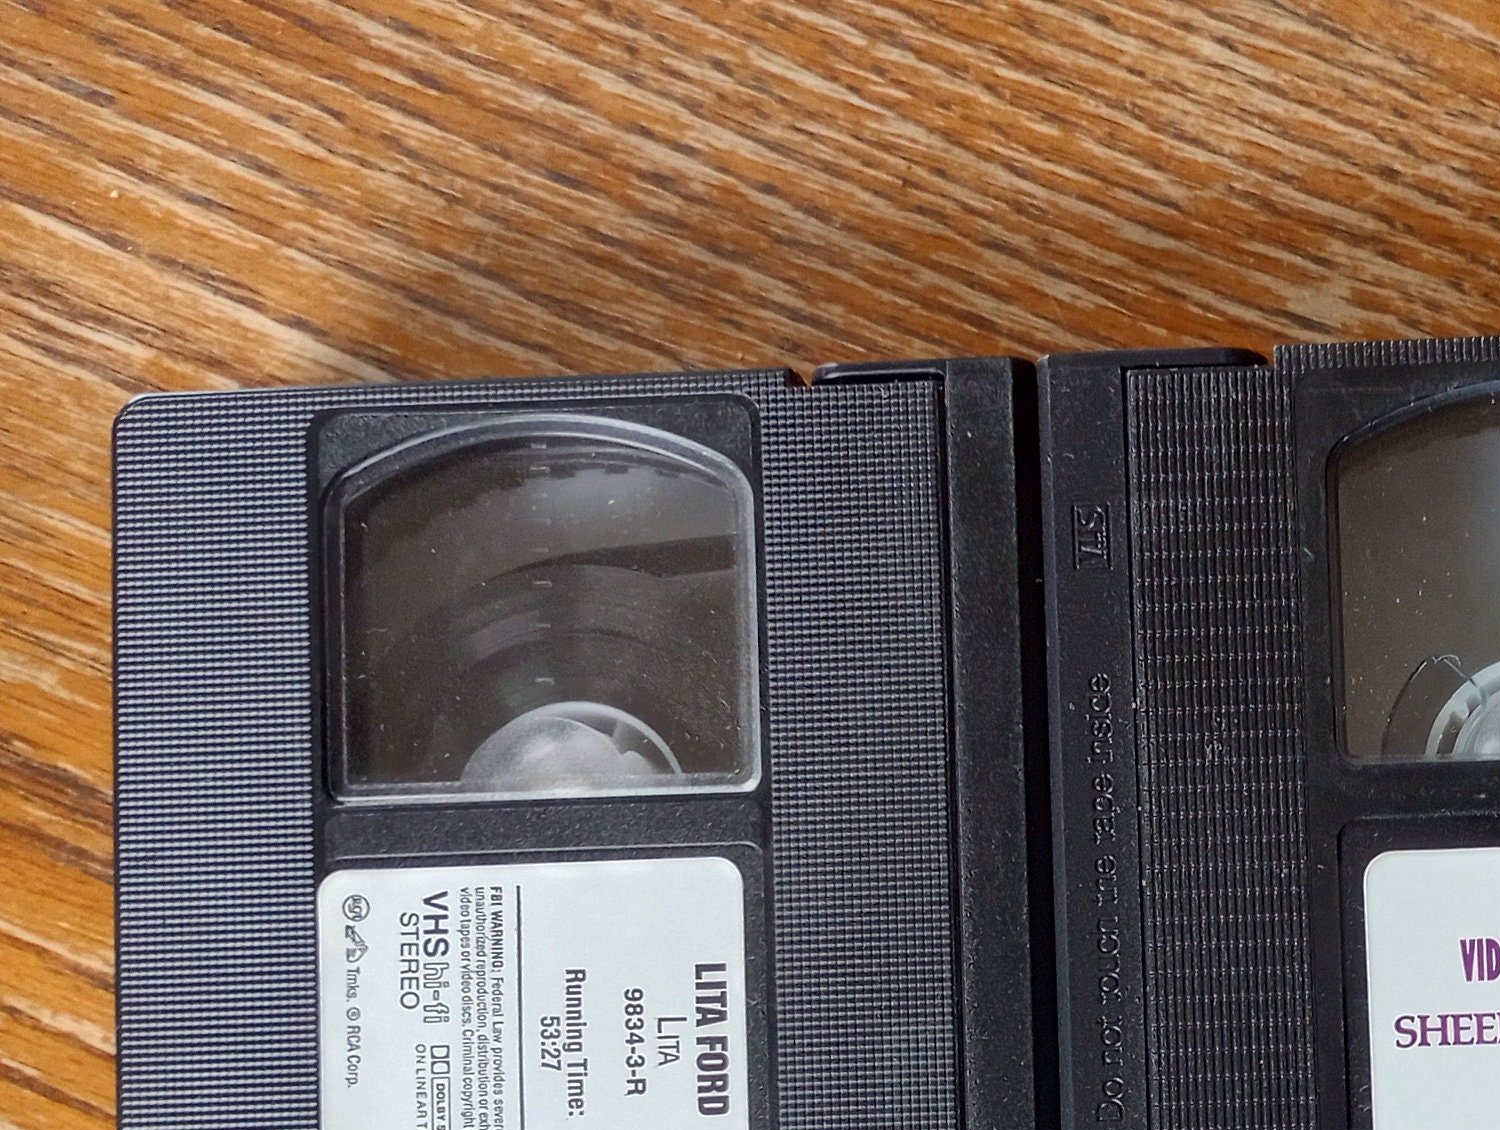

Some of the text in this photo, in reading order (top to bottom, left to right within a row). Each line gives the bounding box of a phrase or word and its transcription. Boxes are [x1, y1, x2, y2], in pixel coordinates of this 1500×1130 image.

[422, 890, 450, 958] VHS
[1085, 673, 1124, 1121] Do not touch the tape inside
[345, 966, 361, 1003] Tmks.
[399, 912, 420, 1010] STEREO
[346, 1025, 361, 1053] RCA
[414, 1043, 427, 1064] ON
[540, 1015, 562, 1071] 53:27
[561, 968, 589, 1117] Running Time:
[623, 988, 647, 1097] 9834-3-R
[656, 1016, 688, 1067] LITA
[694, 962, 730, 1116] LITA FORD
[344, 1054, 362, 1089] Corp.
[415, 1067, 428, 1119] LINEAR
[435, 1082, 446, 1121] DOLBY
